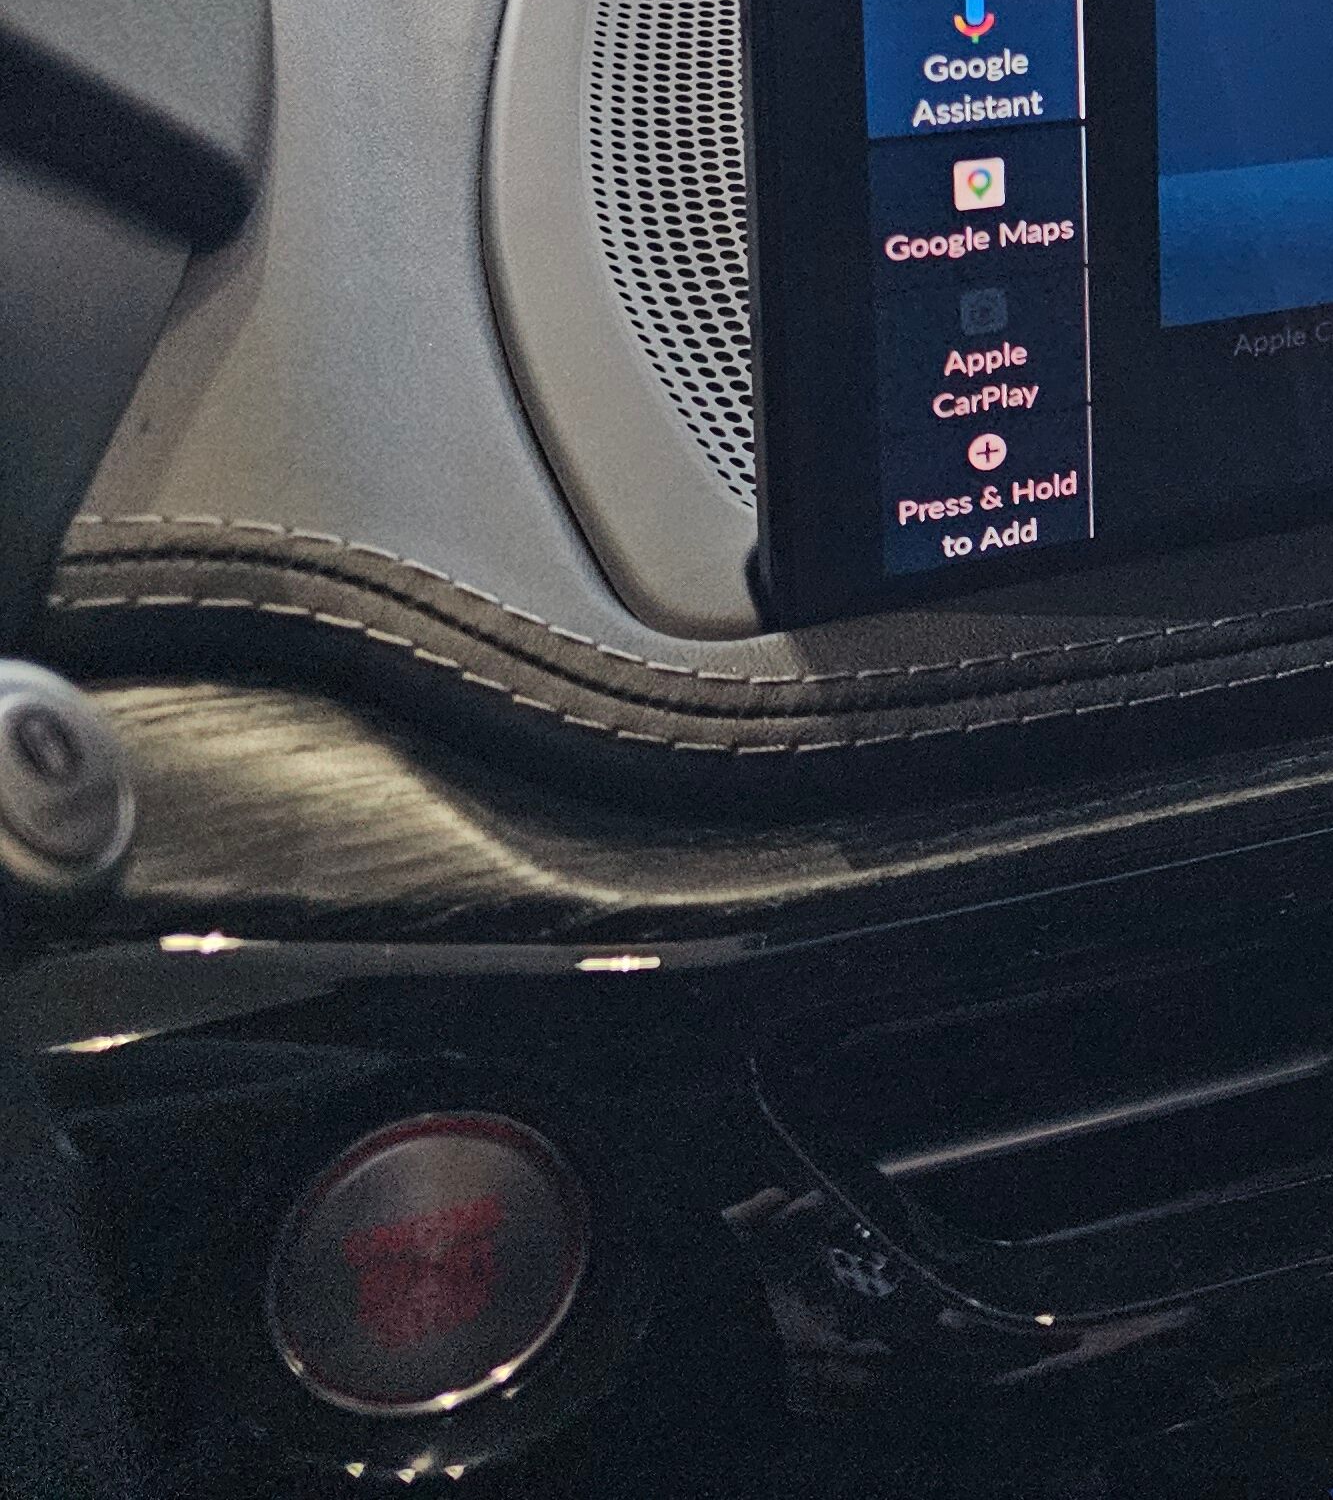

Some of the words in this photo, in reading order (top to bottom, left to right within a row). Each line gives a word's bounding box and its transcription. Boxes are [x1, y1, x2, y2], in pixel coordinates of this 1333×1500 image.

[924, 48, 1029, 83] Google
[912, 90, 1043, 127] Assistant
[885, 226, 990, 261] Google
[999, 218, 1075, 248] Maps
[944, 342, 1027, 377] Apple
[1233, 327, 1307, 358] Apple
[932, 384, 1039, 418] CarPlay
[899, 495, 973, 525] Press
[980, 486, 1003, 511] &
[1011, 471, 1078, 505] Hold
[942, 533, 973, 557] to
[980, 518, 1038, 551] Add
